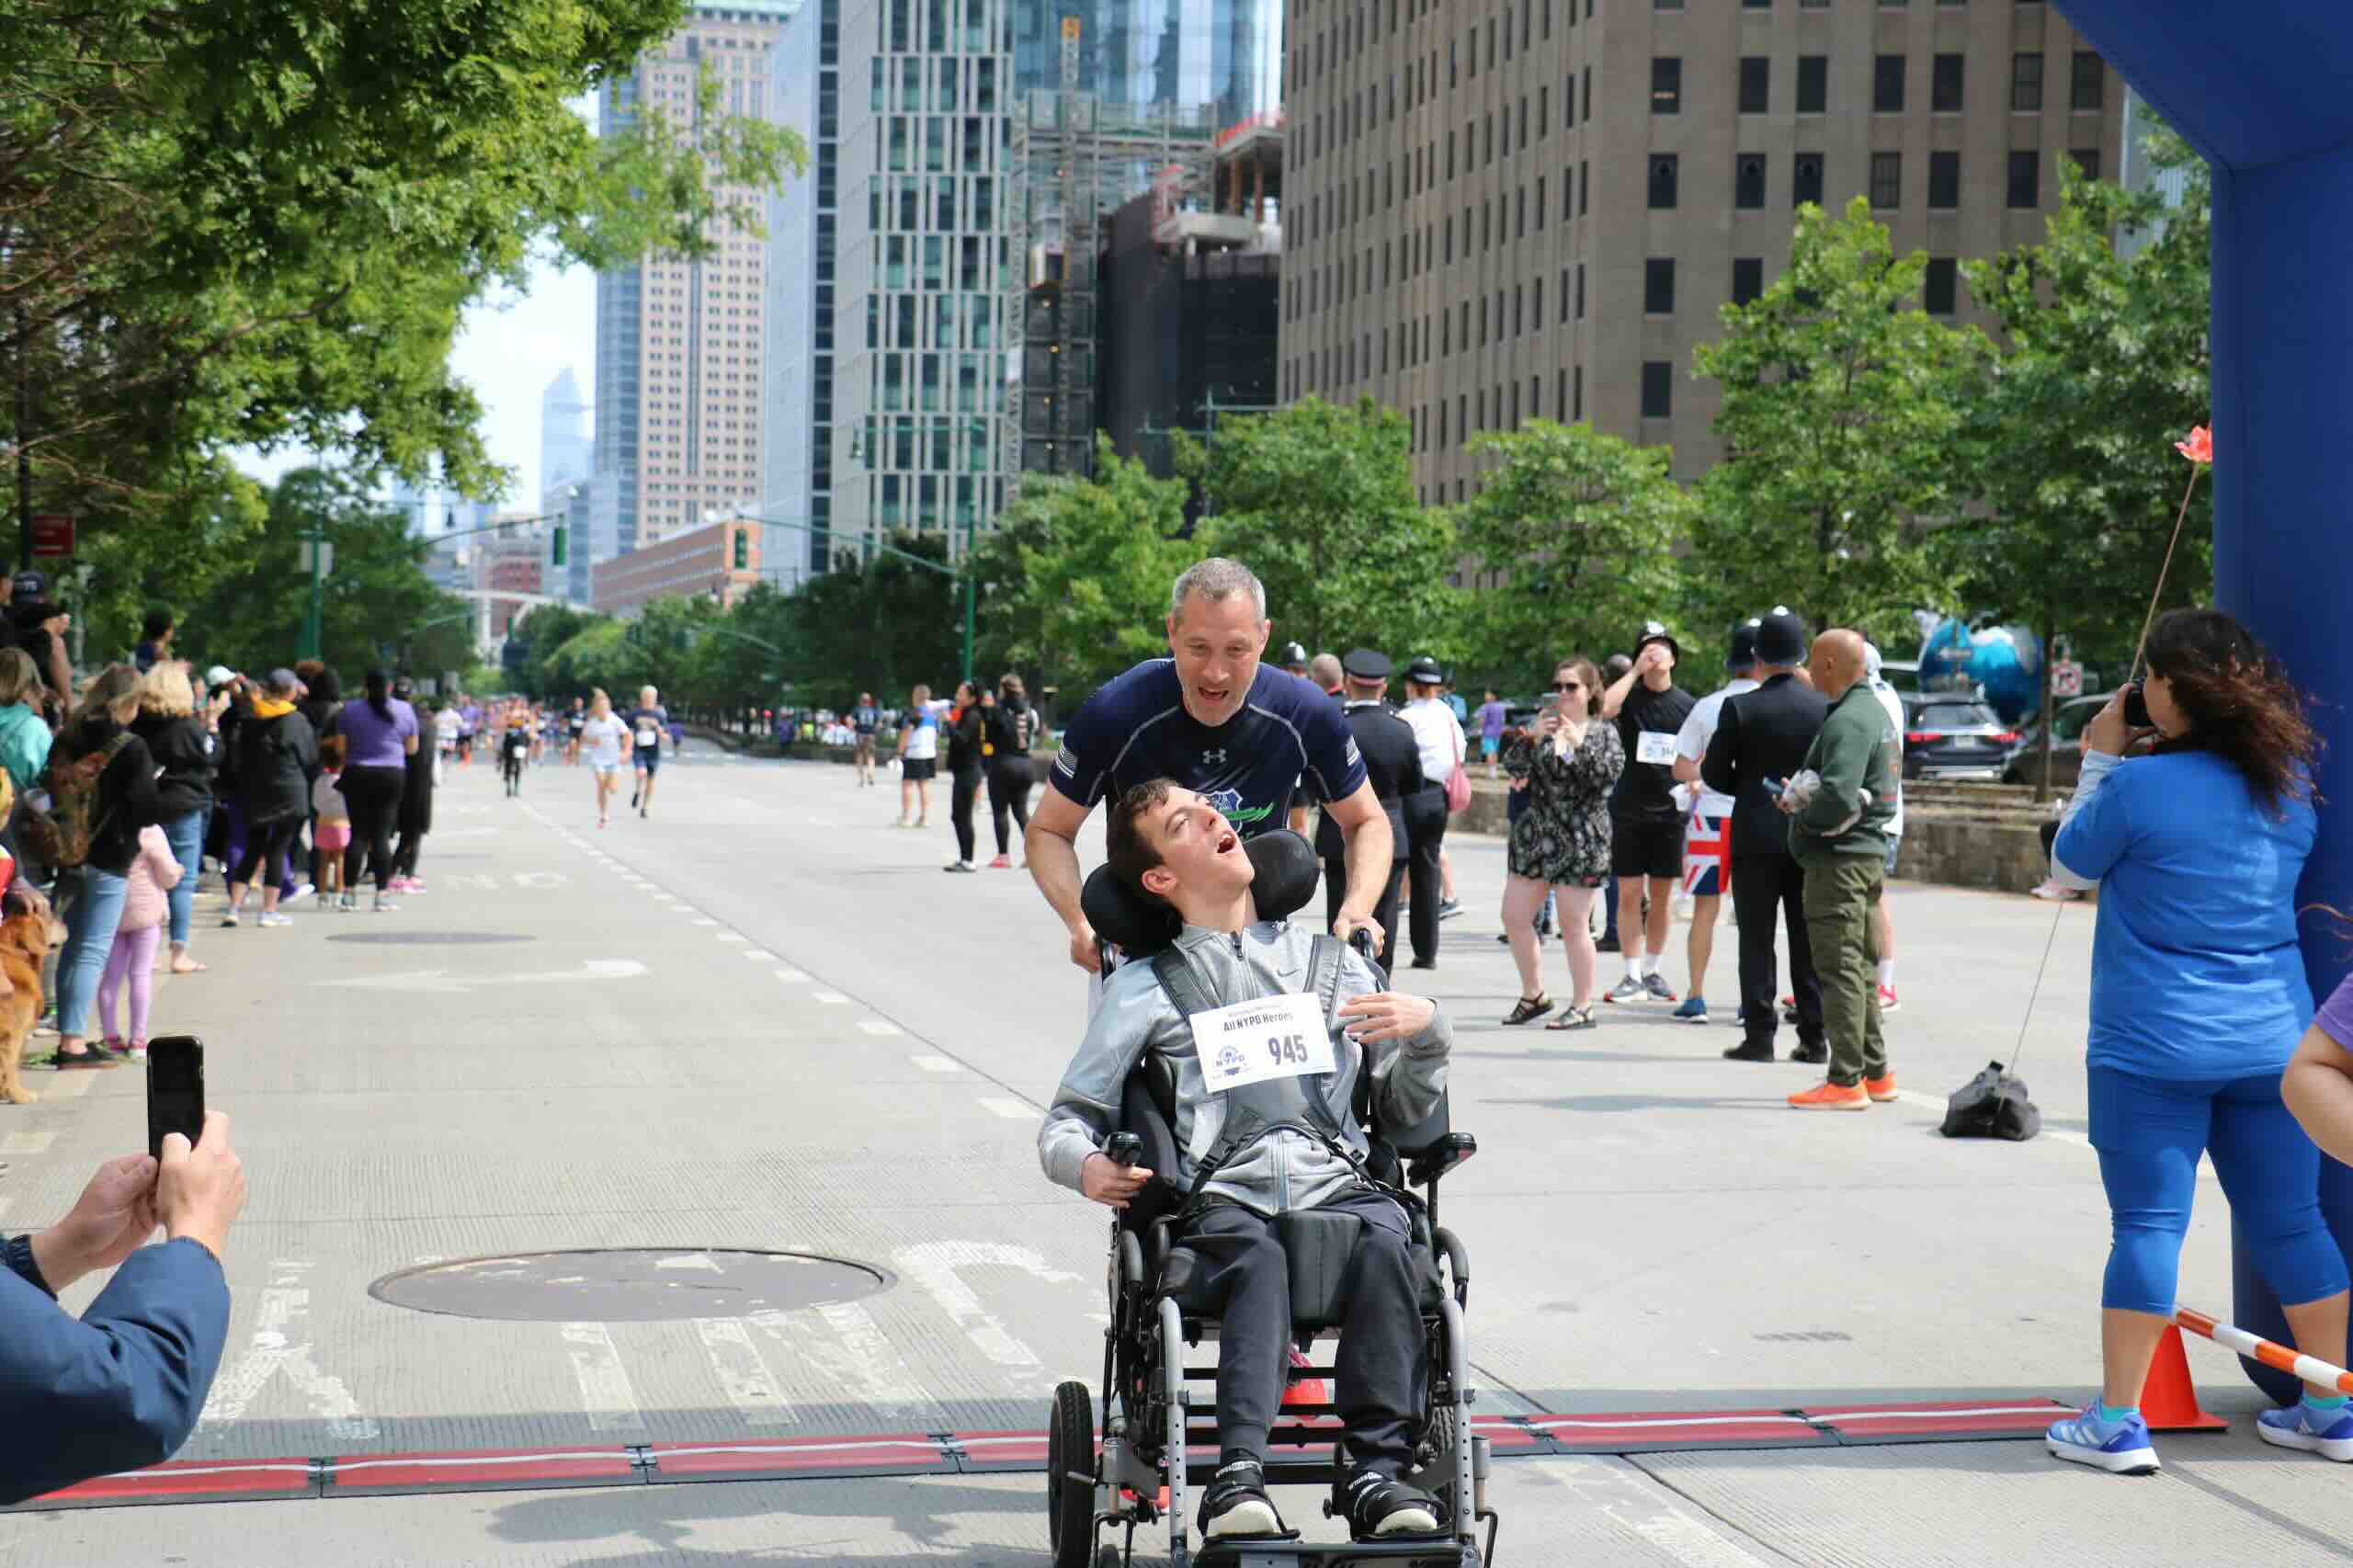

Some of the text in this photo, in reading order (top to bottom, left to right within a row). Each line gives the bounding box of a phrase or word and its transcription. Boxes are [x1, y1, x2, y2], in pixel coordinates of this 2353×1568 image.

[1223, 1011, 1294, 1032] All NYPD Heroes
[1267, 1034, 1309, 1066] 945
